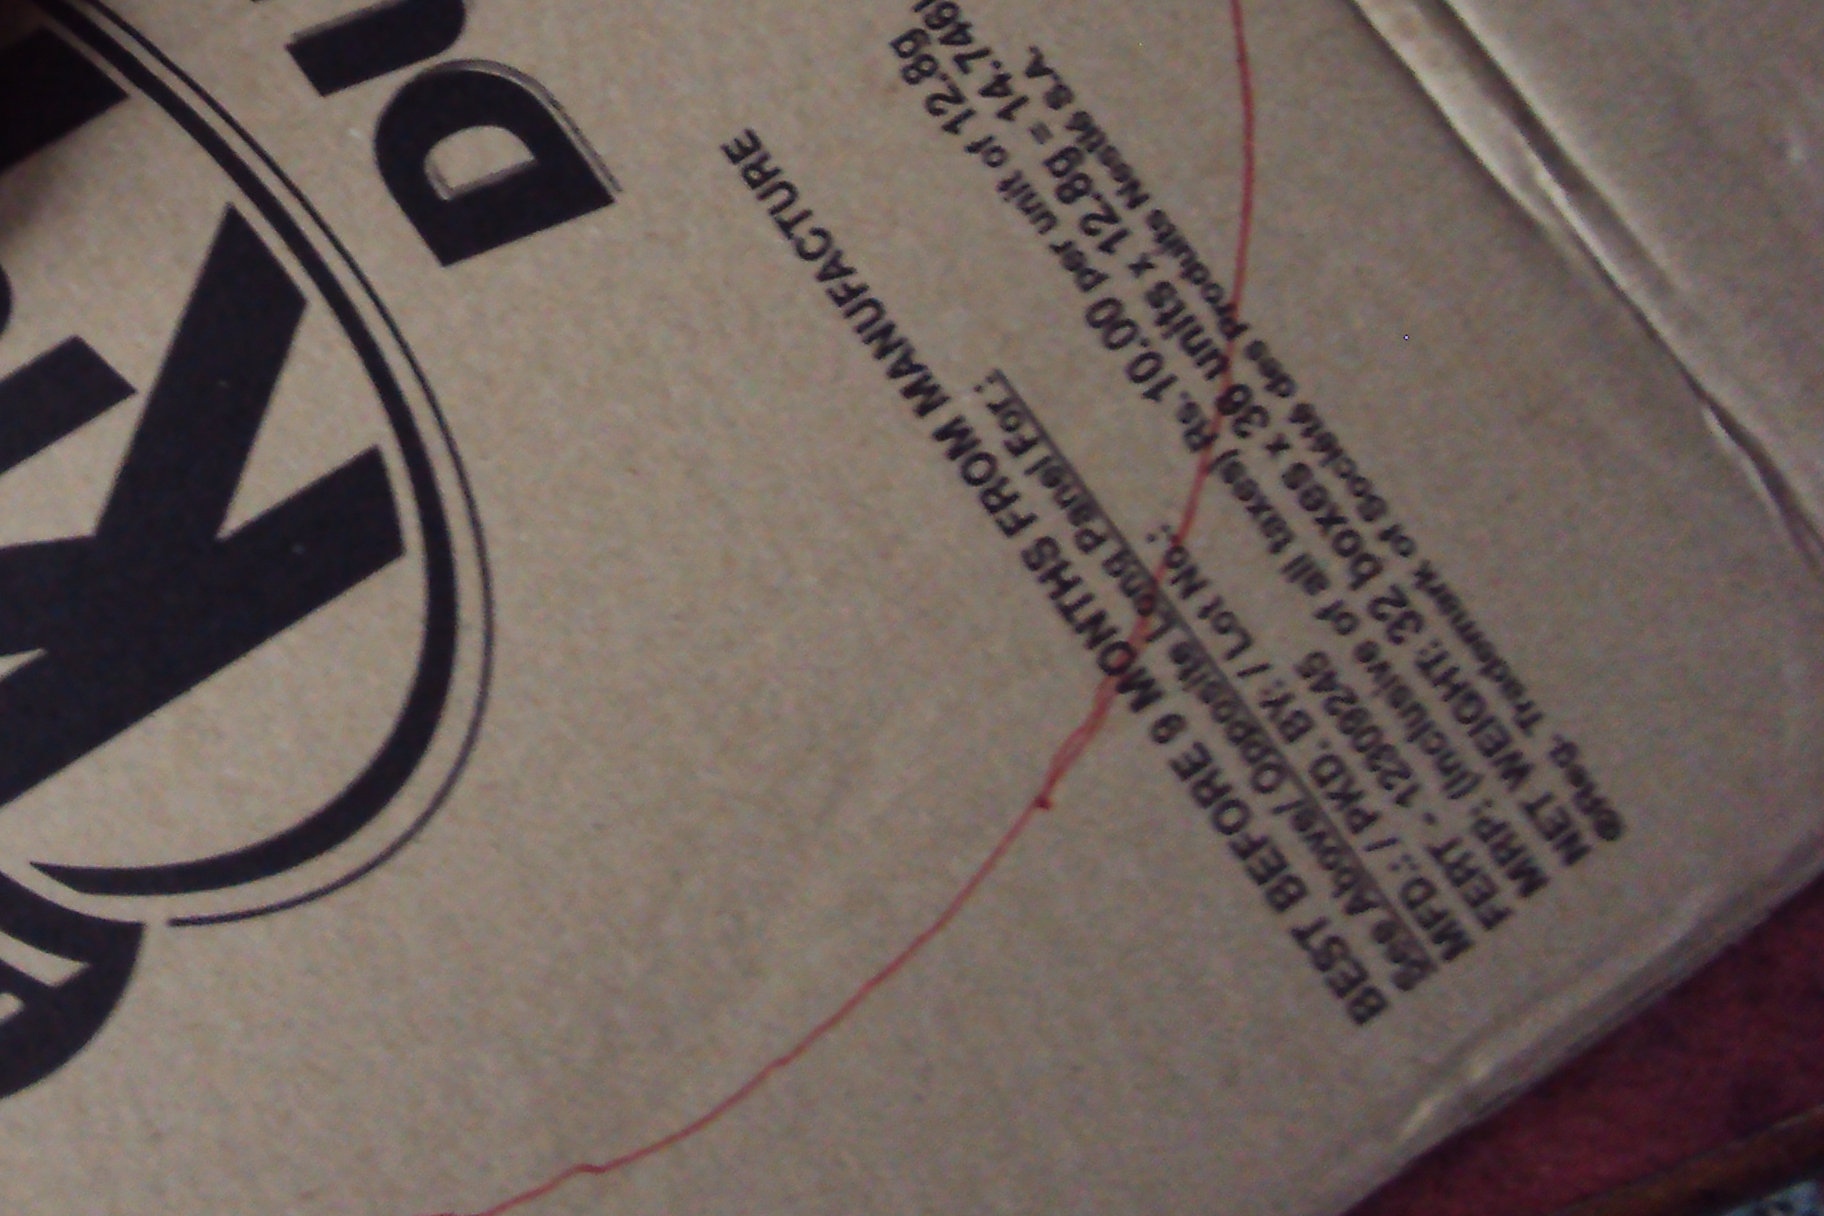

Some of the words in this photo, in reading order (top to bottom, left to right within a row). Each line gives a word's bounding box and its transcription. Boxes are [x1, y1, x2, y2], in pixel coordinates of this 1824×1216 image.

[883, 21, 982, 139] 12.8g
[961, 130, 1011, 173] of
[1036, 139, 1136, 259] 12.8g
[992, 167, 1060, 240] unit
[718, 125, 951, 421] MANUFACTURE
[1046, 232, 1110, 296] per
[1138, 205, 1252, 347] Produits
[1137, 277, 1232, 385] units
[1211, 379, 1273, 442] 36
[928, 411, 1039, 540] FROM
[1022, 451, 1112, 556] Panel
[1274, 458, 1385, 593] boxes
[1279, 550, 1331, 600] all
[1375, 521, 1417, 561] of
[1017, 532, 1165, 715] MONTHS
[1096, 547, 1177, 645] Long
[1193, 594, 1254, 662] Lot
[1312, 596, 1361, 640] of
[1364, 581, 1427, 647] 32
[1406, 557, 1547, 738] Trademark
[1145, 709, 1188, 748] 9
[1166, 739, 1309, 915] BEFORE
[1520, 789, 1593, 868] NET
[1425, 832, 1514, 932] FERT
[1288, 913, 1390, 1028] BEST
